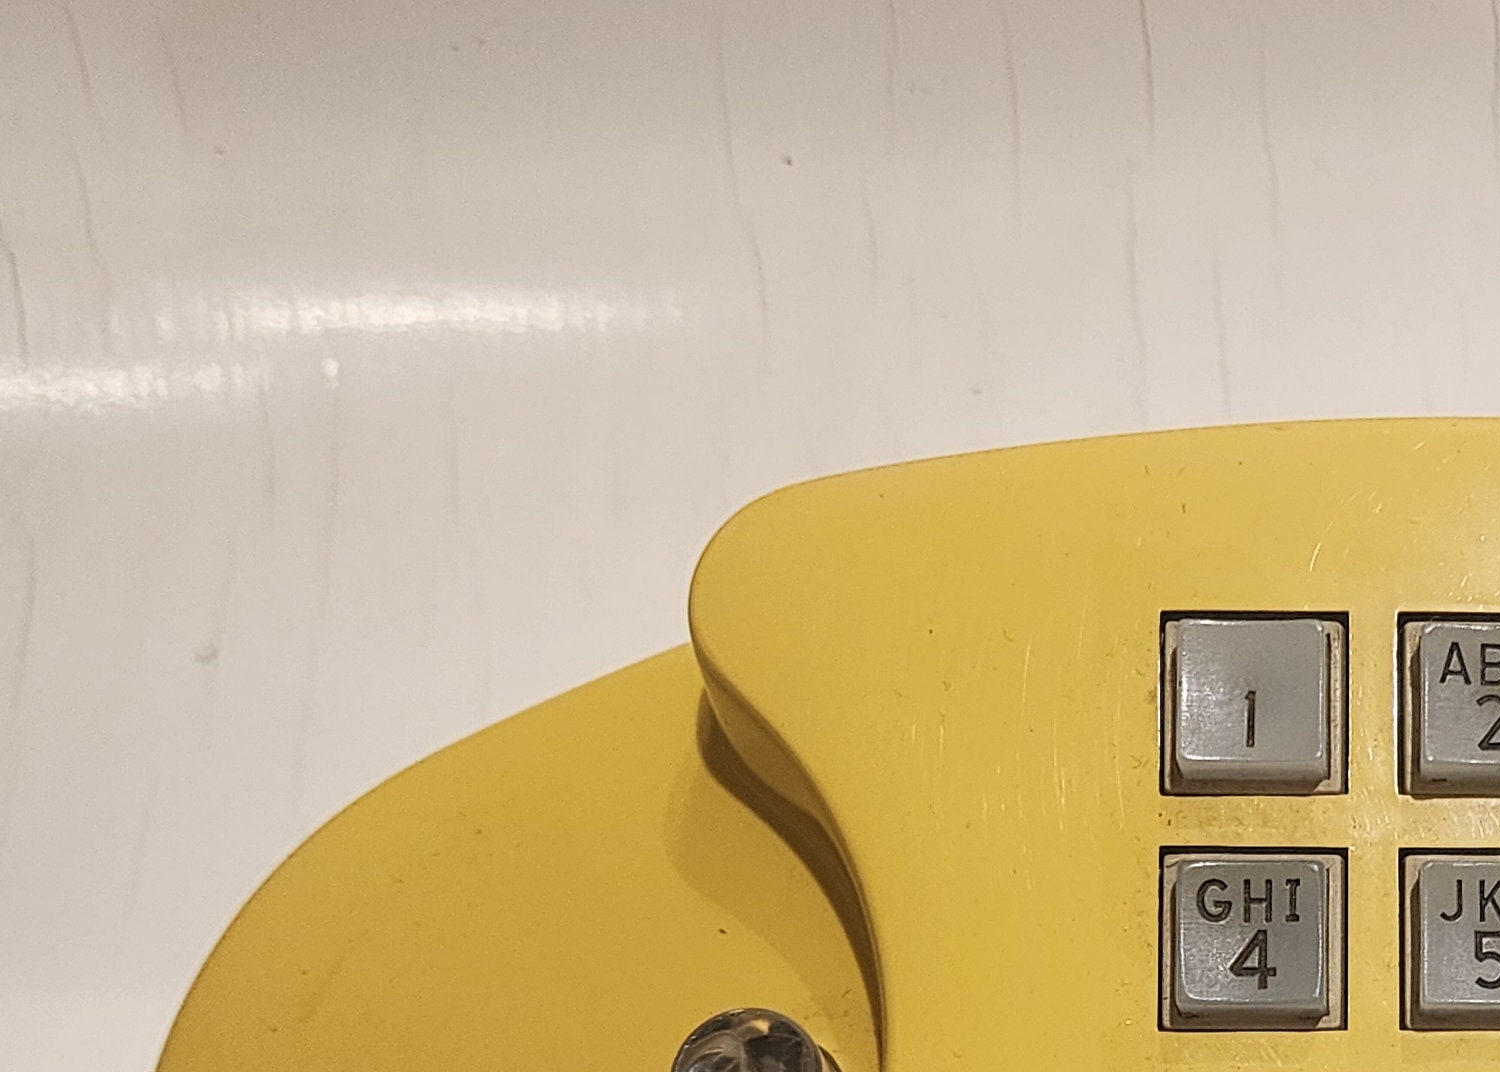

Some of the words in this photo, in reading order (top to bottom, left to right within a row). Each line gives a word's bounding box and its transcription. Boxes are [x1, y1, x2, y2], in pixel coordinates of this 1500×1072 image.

[1244, 690, 1257, 748] 1
[1196, 877, 1301, 924] GHI
[1228, 929, 1277, 990] 4
